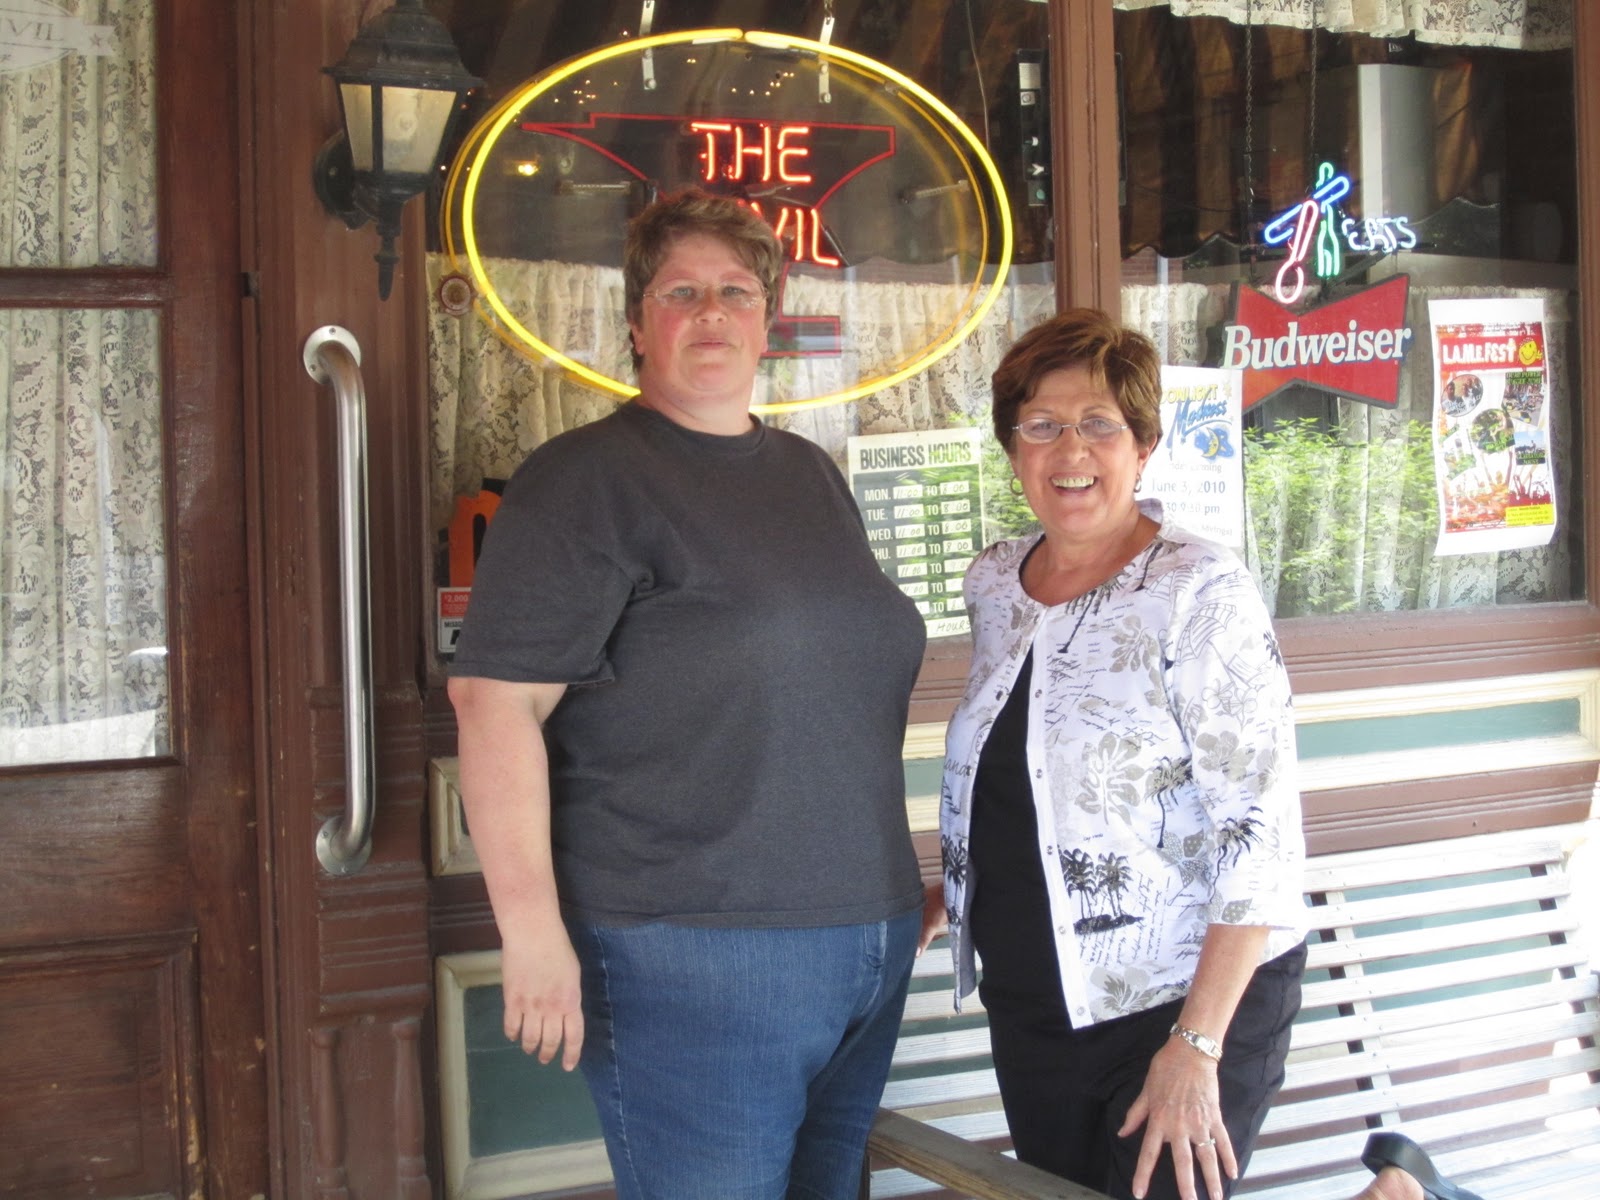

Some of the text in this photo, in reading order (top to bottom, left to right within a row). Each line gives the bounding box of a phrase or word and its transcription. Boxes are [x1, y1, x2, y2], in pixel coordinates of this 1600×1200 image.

[4, 17, 64, 42] VIL
[691, 121, 812, 183] THE
[750, 200, 839, 268] VIL
[1220, 320, 1412, 369] Budweiser
[860, 441, 971, 470] BUSINESS HOURS
[864, 489, 891, 501] MON.
[926, 485, 938, 496] TO
[1198, 481, 1226, 494] 2010
[866, 509, 888, 521] TUE.
[927, 504, 939, 515] TO
[1204, 505, 1221, 516] pm
[868, 529, 893, 541] WED.
[928, 525, 940, 536] TO
[929, 544, 941, 555] TO
[930, 563, 942, 574] TO
[931, 582, 943, 594] TO
[933, 602, 944, 612] TO
